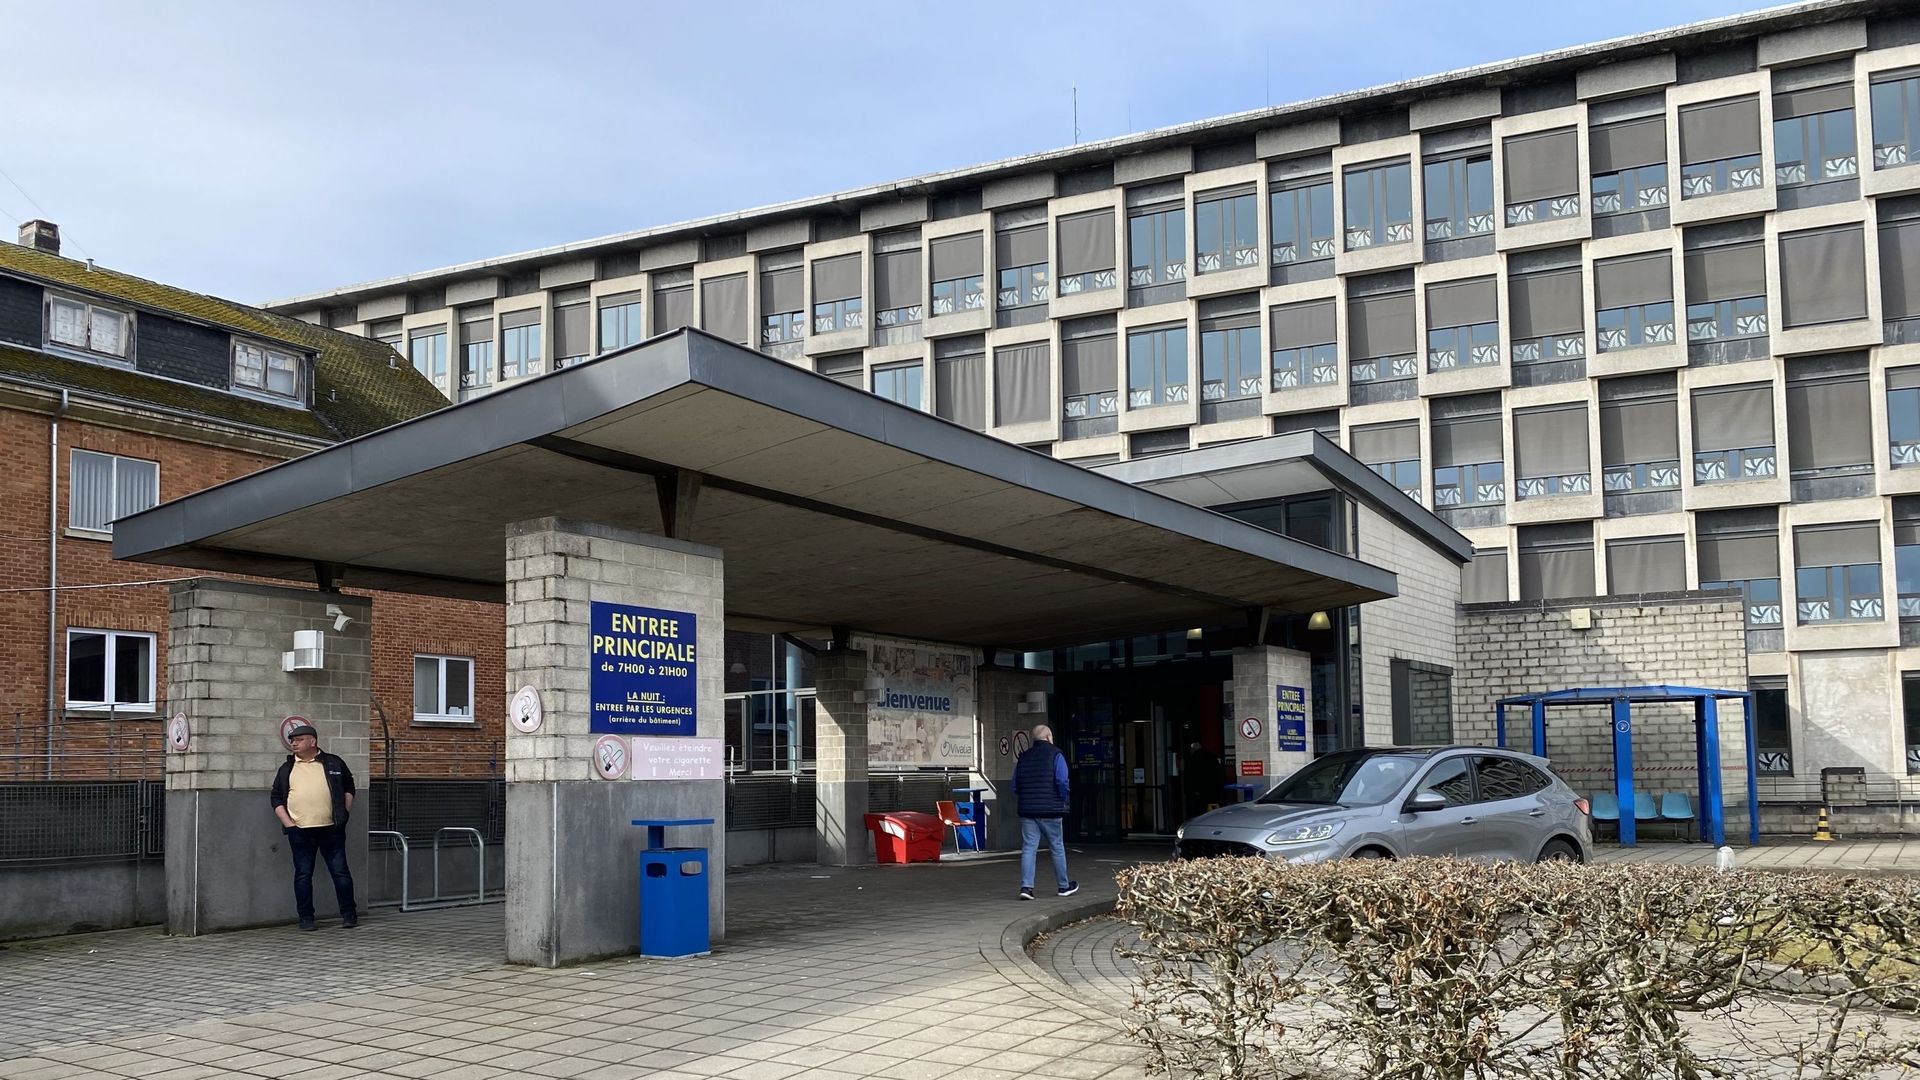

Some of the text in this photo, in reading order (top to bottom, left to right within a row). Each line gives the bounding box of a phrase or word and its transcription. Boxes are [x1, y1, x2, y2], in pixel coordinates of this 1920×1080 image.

[612, 613, 678, 638] ENTREE
[593, 635, 695, 662] PRINCIPALE
[601, 661, 688, 677] de 7H00 à 21H00
[627, 691, 639, 700] LA
[640, 692, 660, 701] NUIT
[877, 688, 950, 711] ienvenue
[1282, 690, 1300, 701] ENTREE
[595, 703, 693, 715] ENTREE PAR LES URGENCES
[638, 716, 647, 724] du
[648, 756, 713, 768] votre cigarette
[668, 767, 693, 777] Merci
